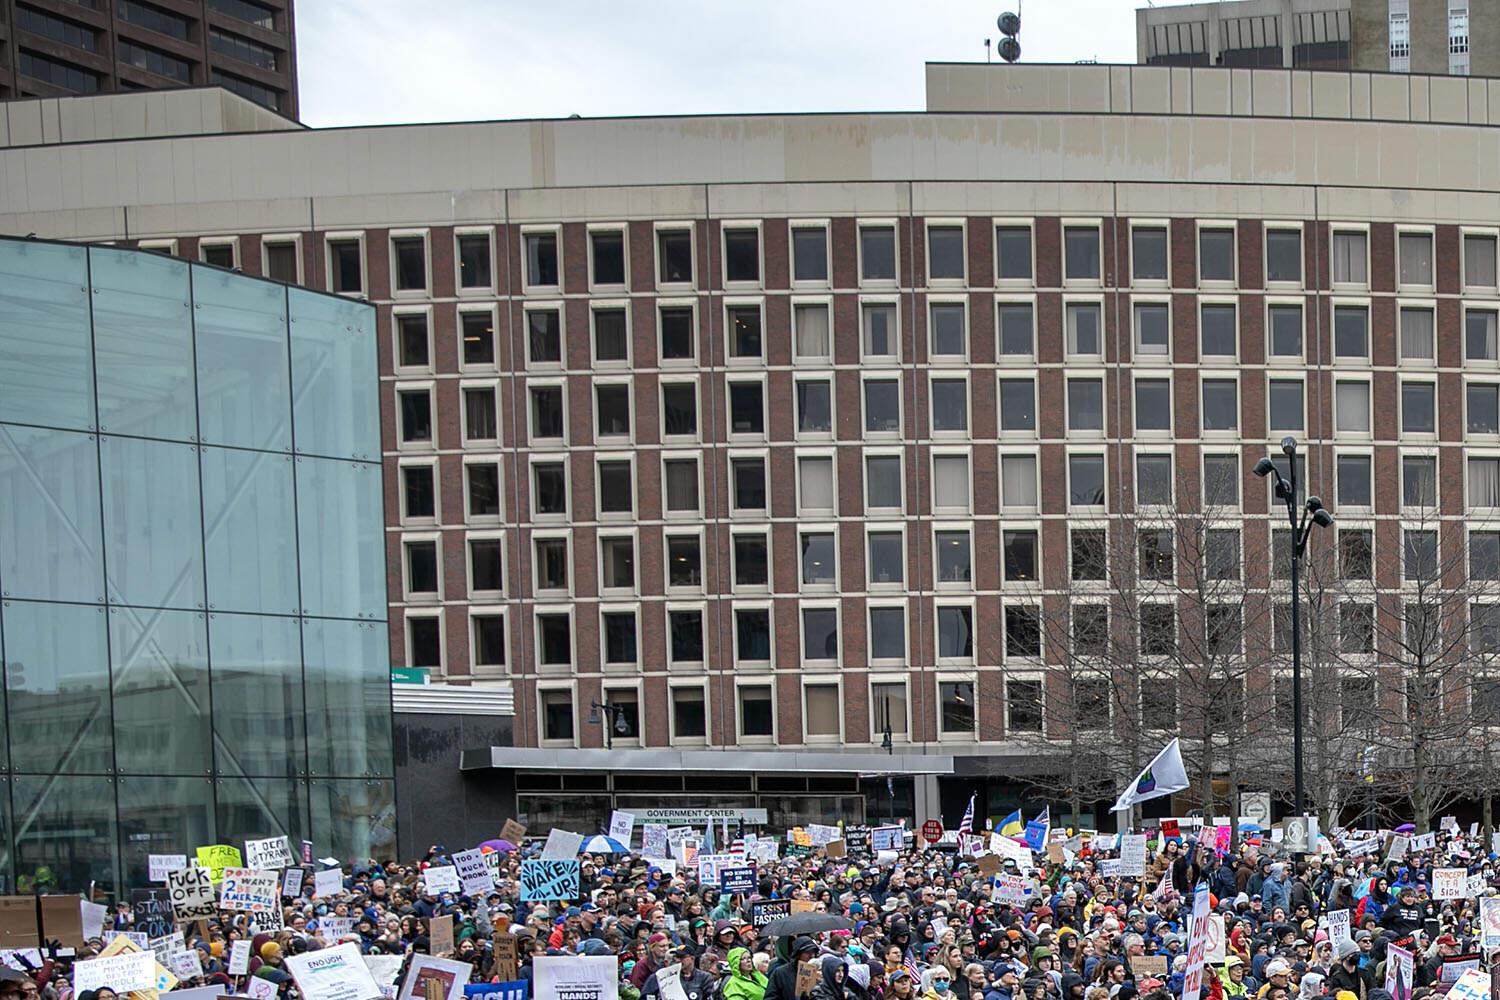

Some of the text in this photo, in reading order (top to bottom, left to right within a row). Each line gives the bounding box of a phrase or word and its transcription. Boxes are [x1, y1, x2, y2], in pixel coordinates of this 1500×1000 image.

[210, 846, 239, 859] FREE
[456, 854, 472, 863] TOO
[461, 863, 484, 872] MUCH
[168, 869, 209, 888] FUCK
[462, 871, 488, 881] WRONG
[523, 862, 565, 892] WAKE
[1435, 870, 1466, 879] CONCEPT
[242, 878, 275, 886] WANT
[551, 875, 578, 898] UP!
[173, 887, 209, 900] OFF
[226, 880, 271, 896] 2 BE AN
[1440, 888, 1460, 896] SIGN
[137, 900, 173, 914] STAND
[225, 901, 273, 911] IDIOT
[753, 903, 787, 914] RESIST
[754, 912, 789, 925] FASCISM
[1328, 912, 1348, 921] HANDS
[136, 921, 173, 938] CORY
[1333, 926, 1345, 935] OFF
[308, 955, 343, 968] ENOUGH
[561, 992, 597, 1000] HANDS
